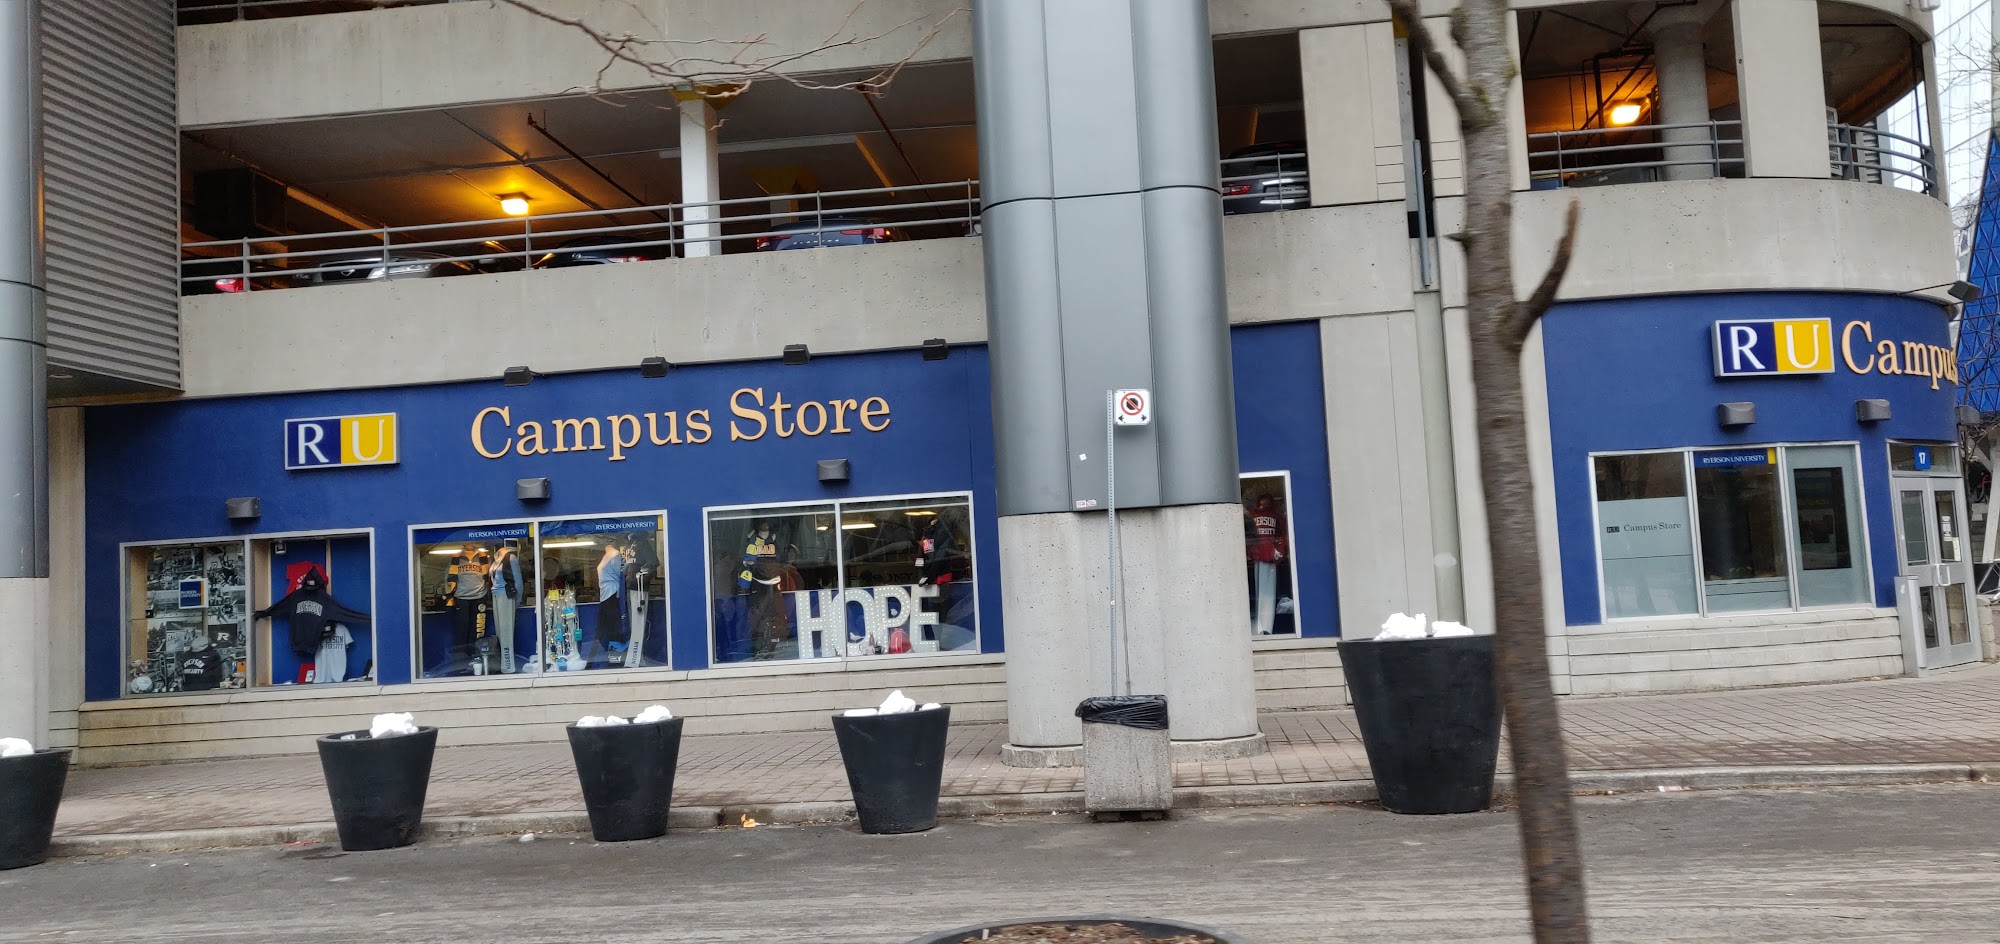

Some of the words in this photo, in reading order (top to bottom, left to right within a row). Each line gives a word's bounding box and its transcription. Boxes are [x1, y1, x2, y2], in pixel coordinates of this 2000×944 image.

[470, 405, 712, 461] Campus
[729, 387, 891, 442] Store
[1703, 456, 1731, 464] RYERSON
[1731, 454, 1766, 463] UNIVERSITY
[1918, 452, 1926, 465] 17
[595, 523, 622, 531] RYERSON
[622, 521, 656, 529] UNIVERSITY
[1255, 516, 1277, 528] ERSON
[1623, 524, 1657, 533] Campus
[1658, 522, 1682, 530] Store
[468, 530, 494, 538] RYERSON
[494, 528, 527, 537] UNIVERSITY
[457, 563, 482, 573] RYERSON
[795, 583, 940, 660] HOPE
